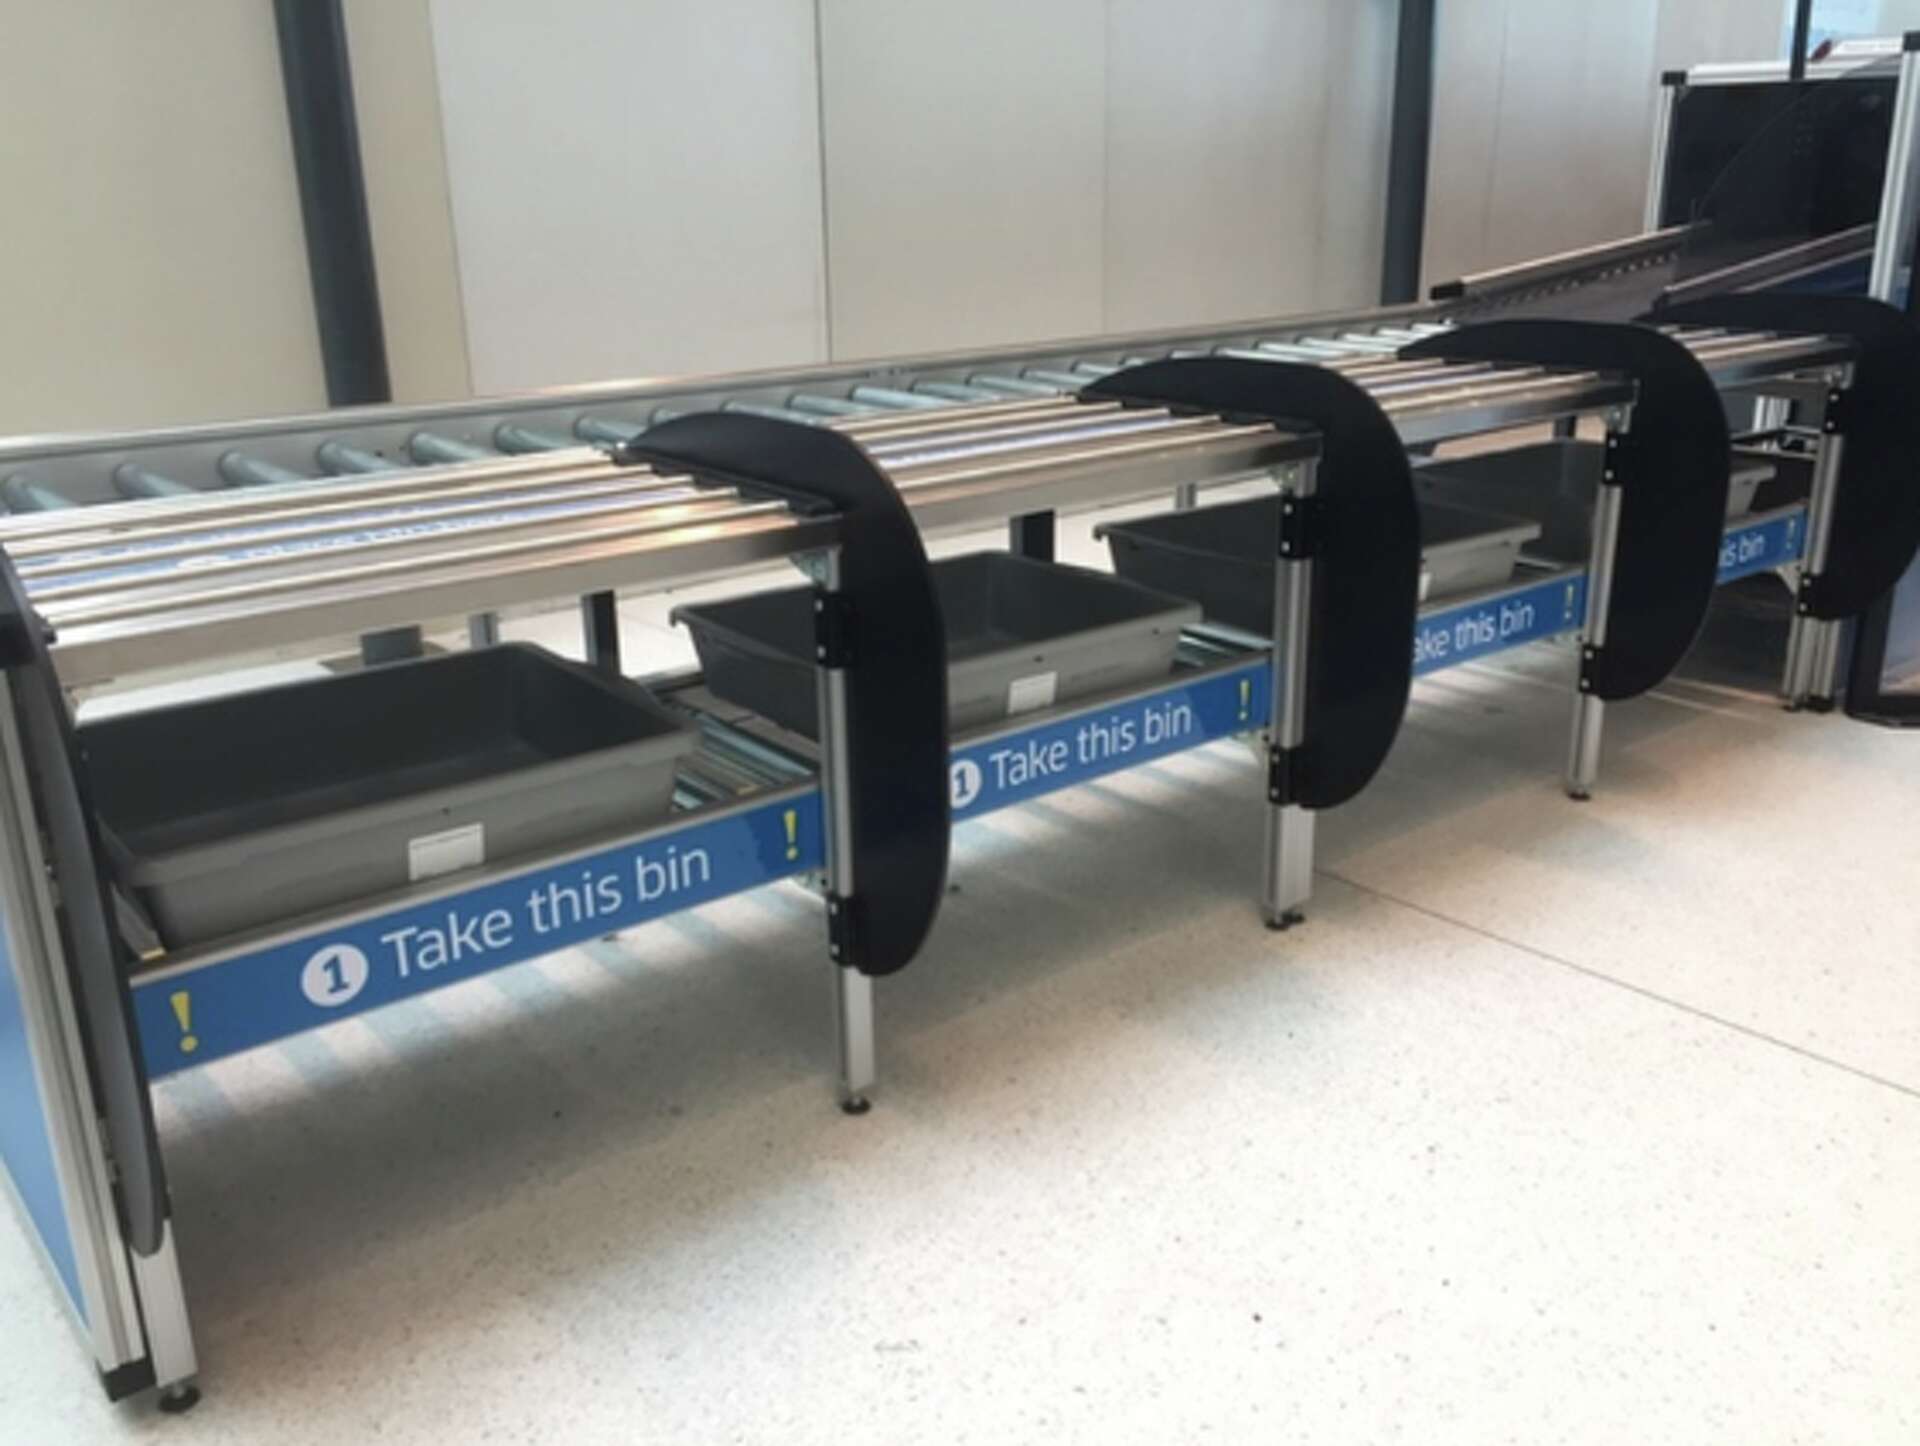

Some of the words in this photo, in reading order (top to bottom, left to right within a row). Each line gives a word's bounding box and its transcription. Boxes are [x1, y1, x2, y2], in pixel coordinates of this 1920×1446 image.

[1738, 531, 1765, 562] bin
[1413, 628, 1450, 663] ake
[1454, 611, 1496, 650] this
[1500, 601, 1536, 637] bin
[989, 738, 1068, 790] Take
[1077, 717, 1137, 763] this
[1144, 701, 1192, 744] bin
[322, 954, 350, 994] 1
[381, 911, 513, 979] Take
[526, 873, 623, 934] this
[635, 846, 711, 900] bin
